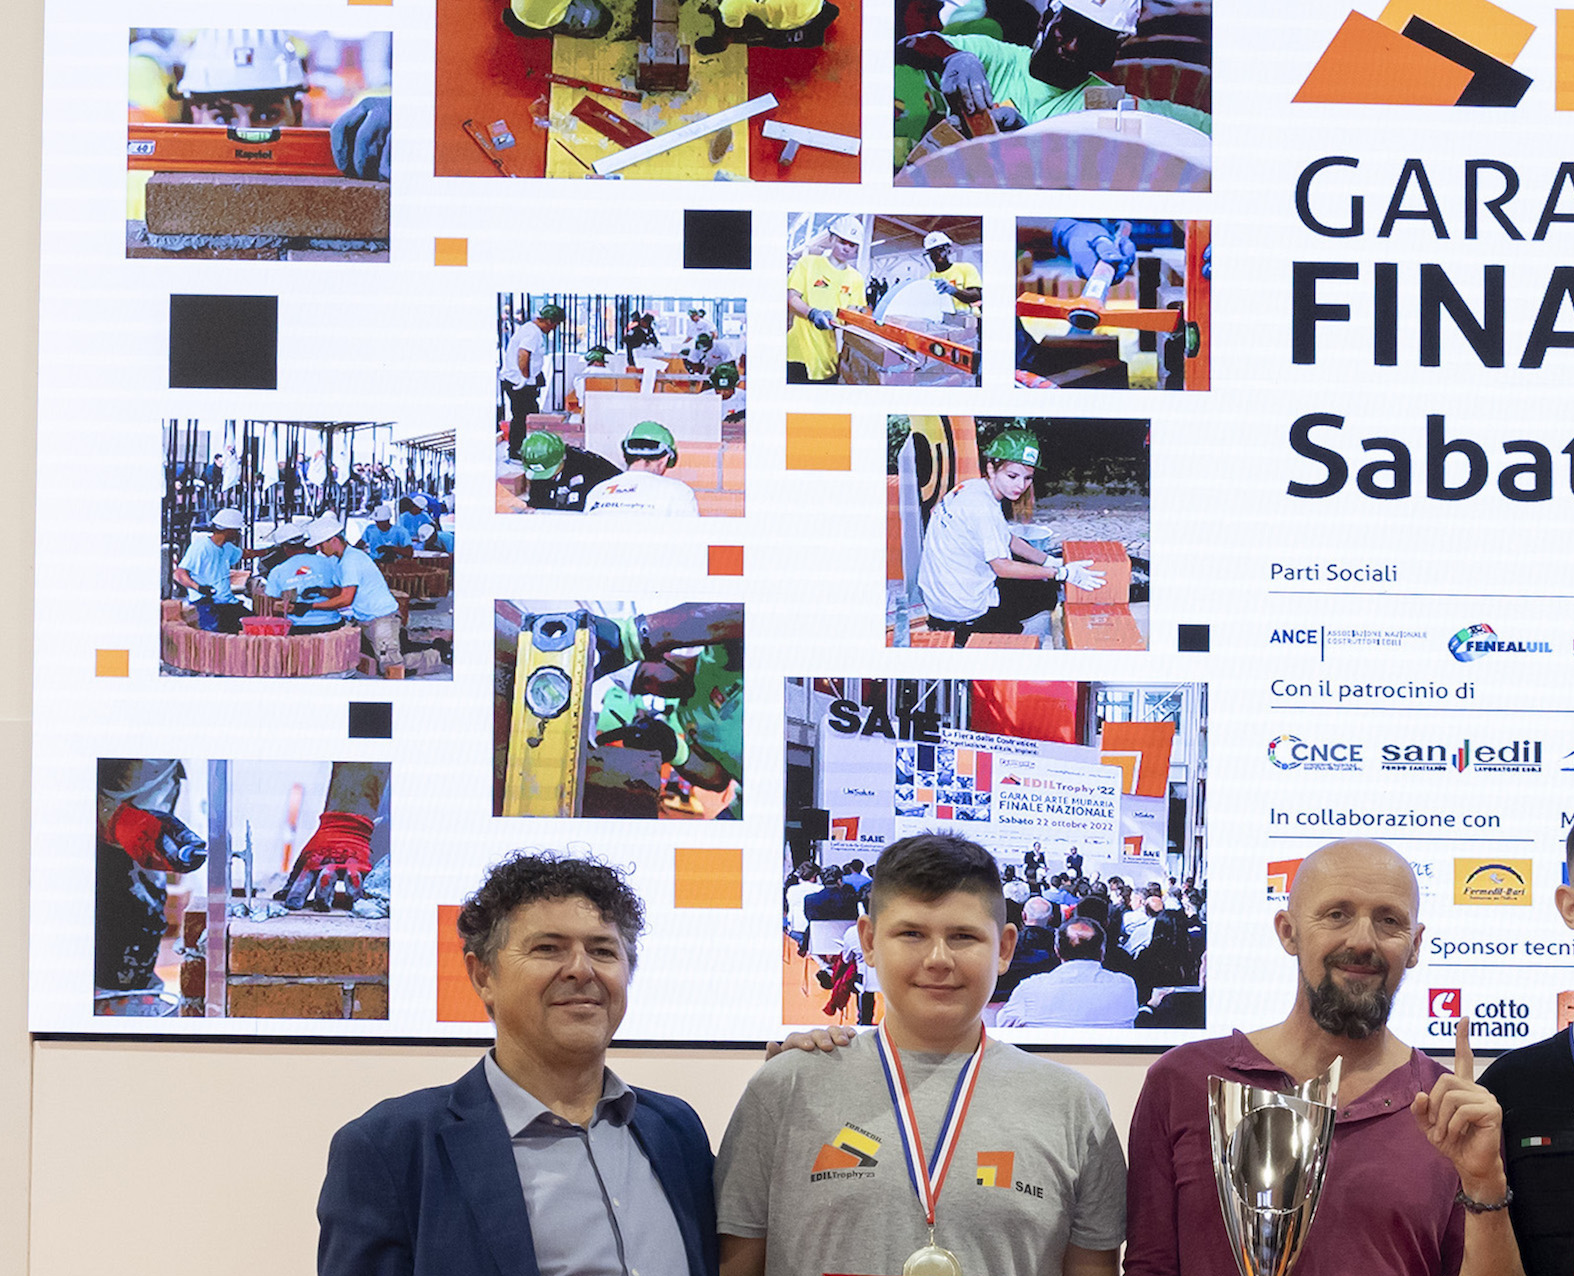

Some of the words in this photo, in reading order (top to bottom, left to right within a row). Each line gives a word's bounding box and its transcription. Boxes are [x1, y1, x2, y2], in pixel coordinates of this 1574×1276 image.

[1271, 565, 1321, 581] Parti
[1326, 565, 1397, 582] Sociali
[1270, 630, 1317, 644] ANCE
[1466, 641, 1553, 653] FENEALUIL
[1271, 679, 1315, 697] Con
[1318, 679, 1332, 697] il
[1338, 681, 1450, 702] patrocinio
[1455, 682, 1475, 699] di
[1291, 744, 1363, 762] CNCE
[1000, 791, 1026, 801] GARA
[1031, 794, 1042, 802] DI
[1044, 795, 1068, 804] ARTE
[999, 801, 1043, 813] FINALE
[1047, 804, 1114, 818] NAZIONALE
[1271, 808, 1290, 824] In
[1296, 809, 1455, 827] collaborazione
[1463, 814, 1500, 827] con
[999, 815, 1034, 826] Sabato
[1037, 818, 1049, 826] 22
[1051, 820, 1087, 830] ottobre
[1090, 822, 1113, 831] 2022
[860, 835, 885, 843] SAIE
[1431, 938, 1517, 957] Sponsor
[1475, 999, 1530, 1018] cotto
[1015, 1180, 1044, 1199] SAIE
